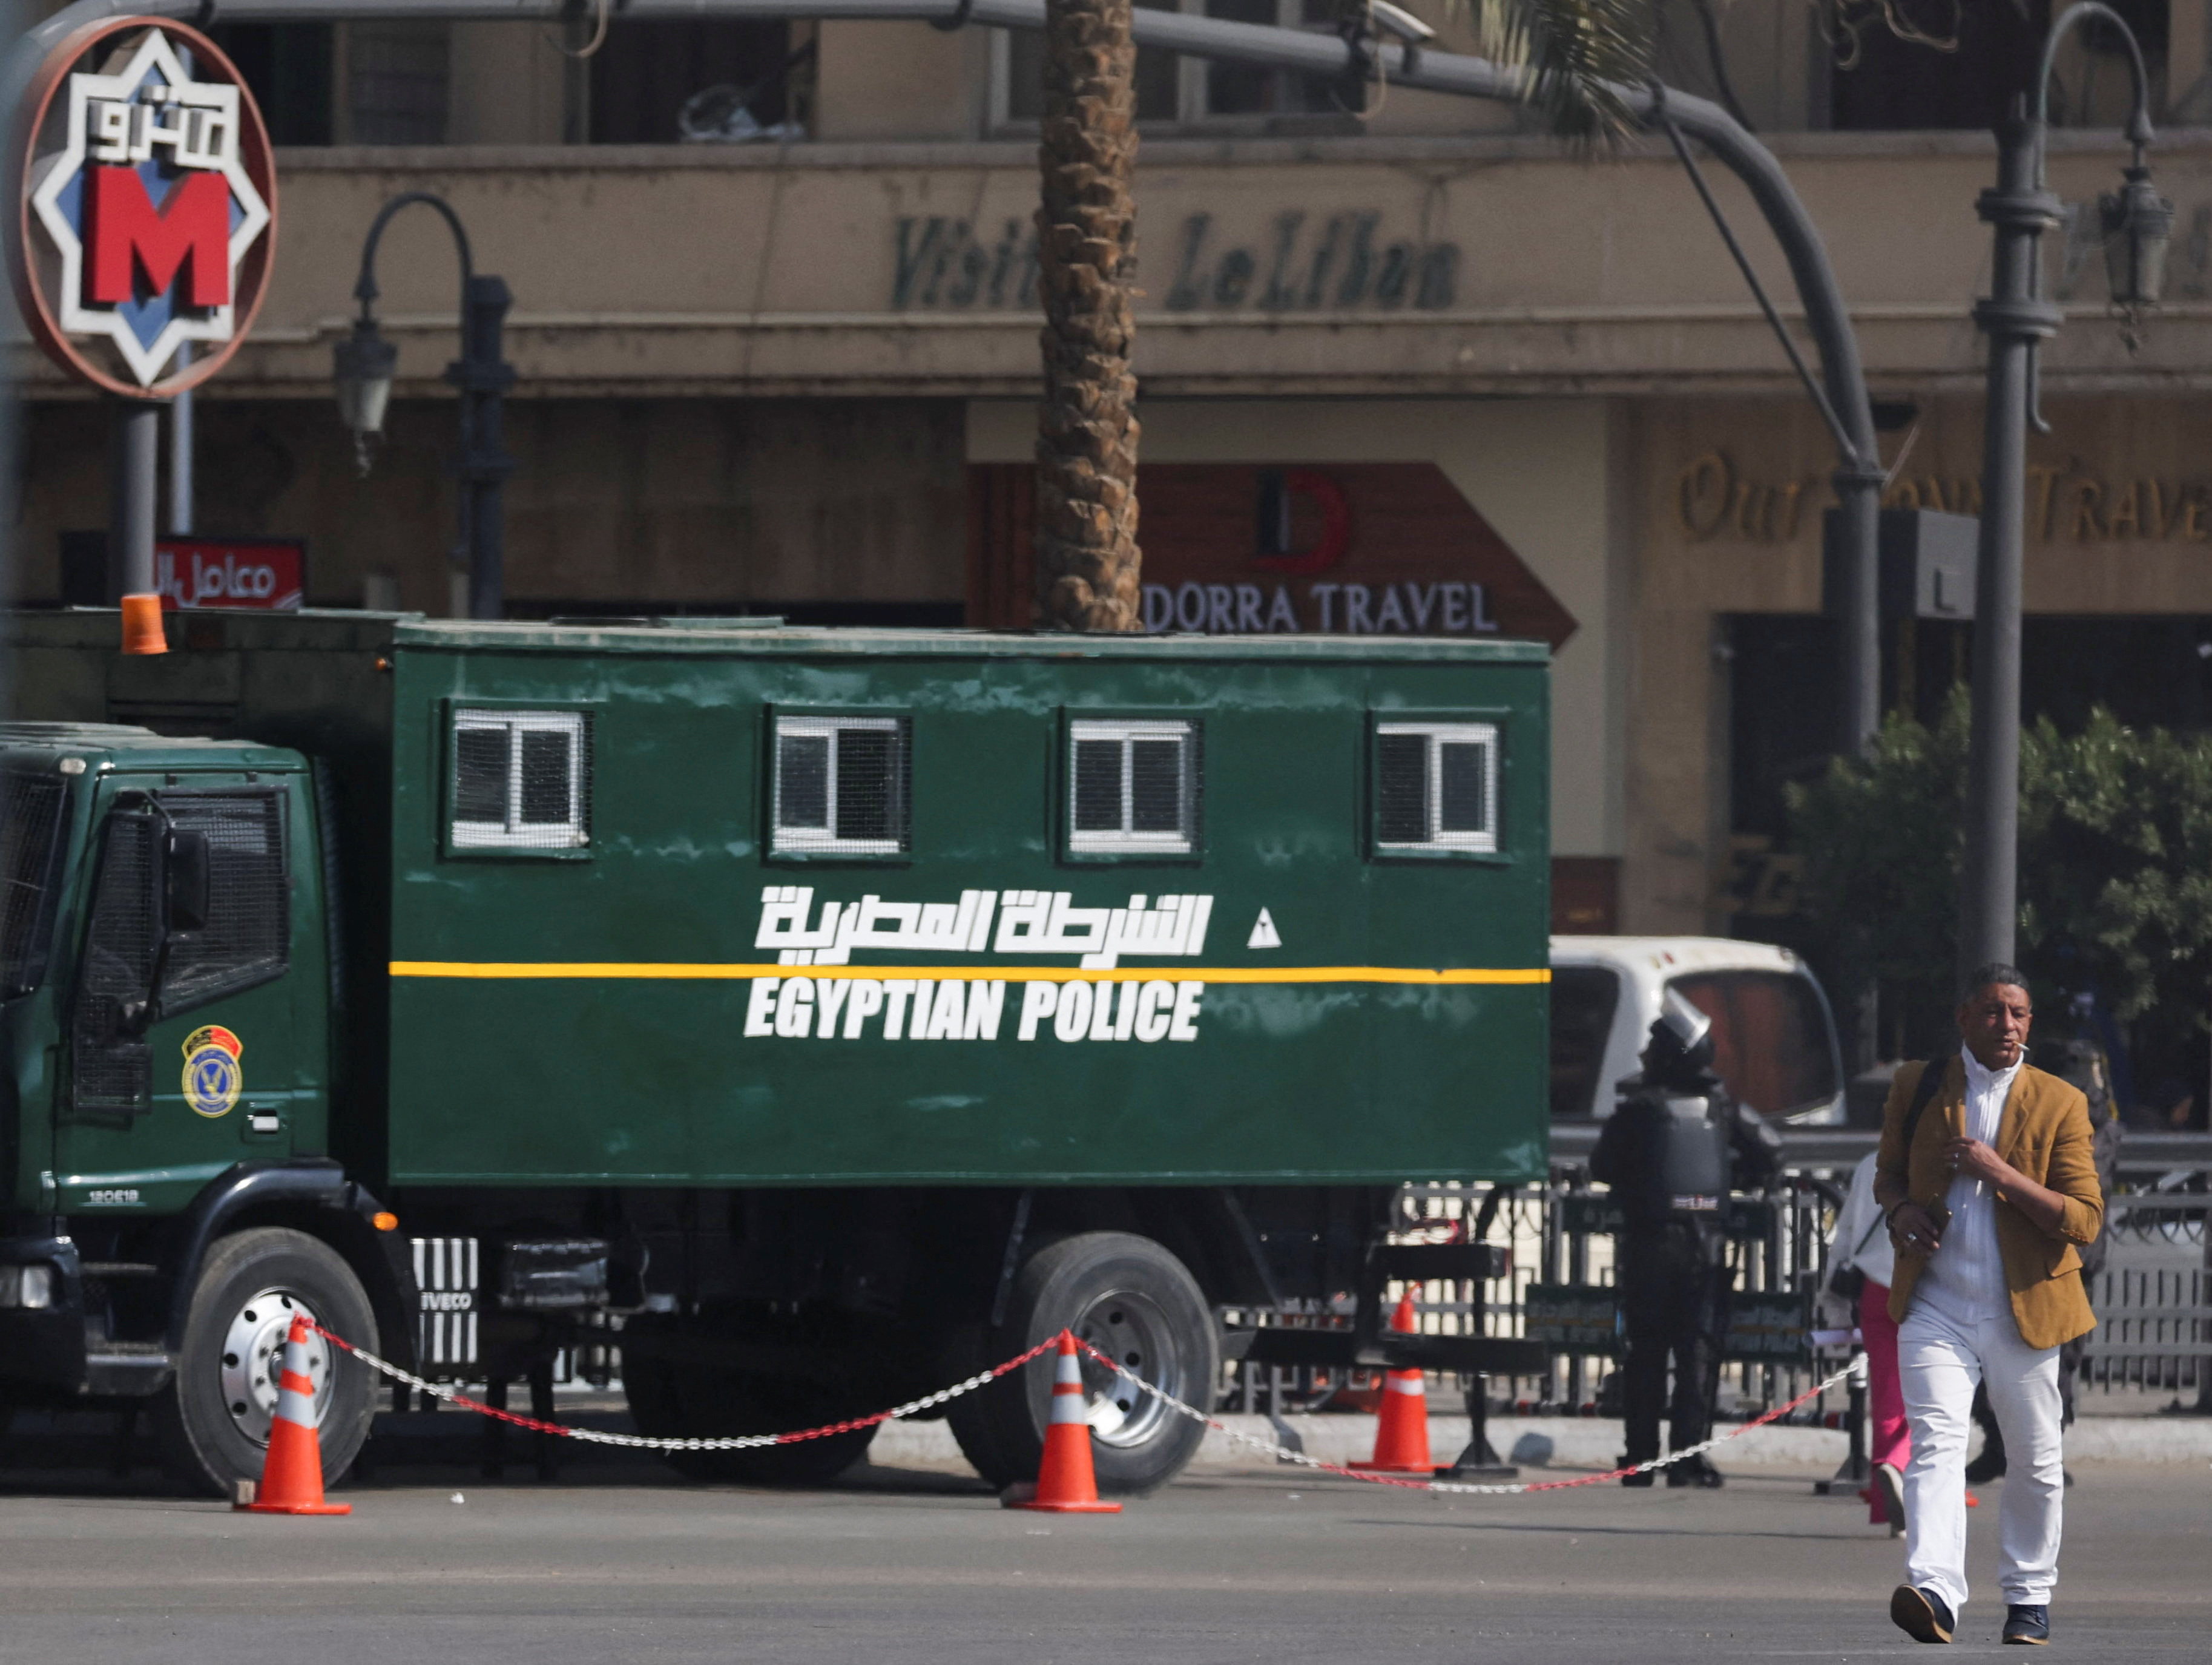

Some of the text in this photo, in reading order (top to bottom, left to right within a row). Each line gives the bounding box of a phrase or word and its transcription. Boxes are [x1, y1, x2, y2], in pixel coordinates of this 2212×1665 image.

[95, 85, 227, 169] مترو
[92, 166, 229, 306] M
[1143, 582, 1498, 632] DORRA TRAVEL
[754, 886, 1214, 971] الشرطة المصرية
[743, 977, 1204, 1043] EGYPTIAN POLICE
[421, 1292, 472, 1310] IVECO
